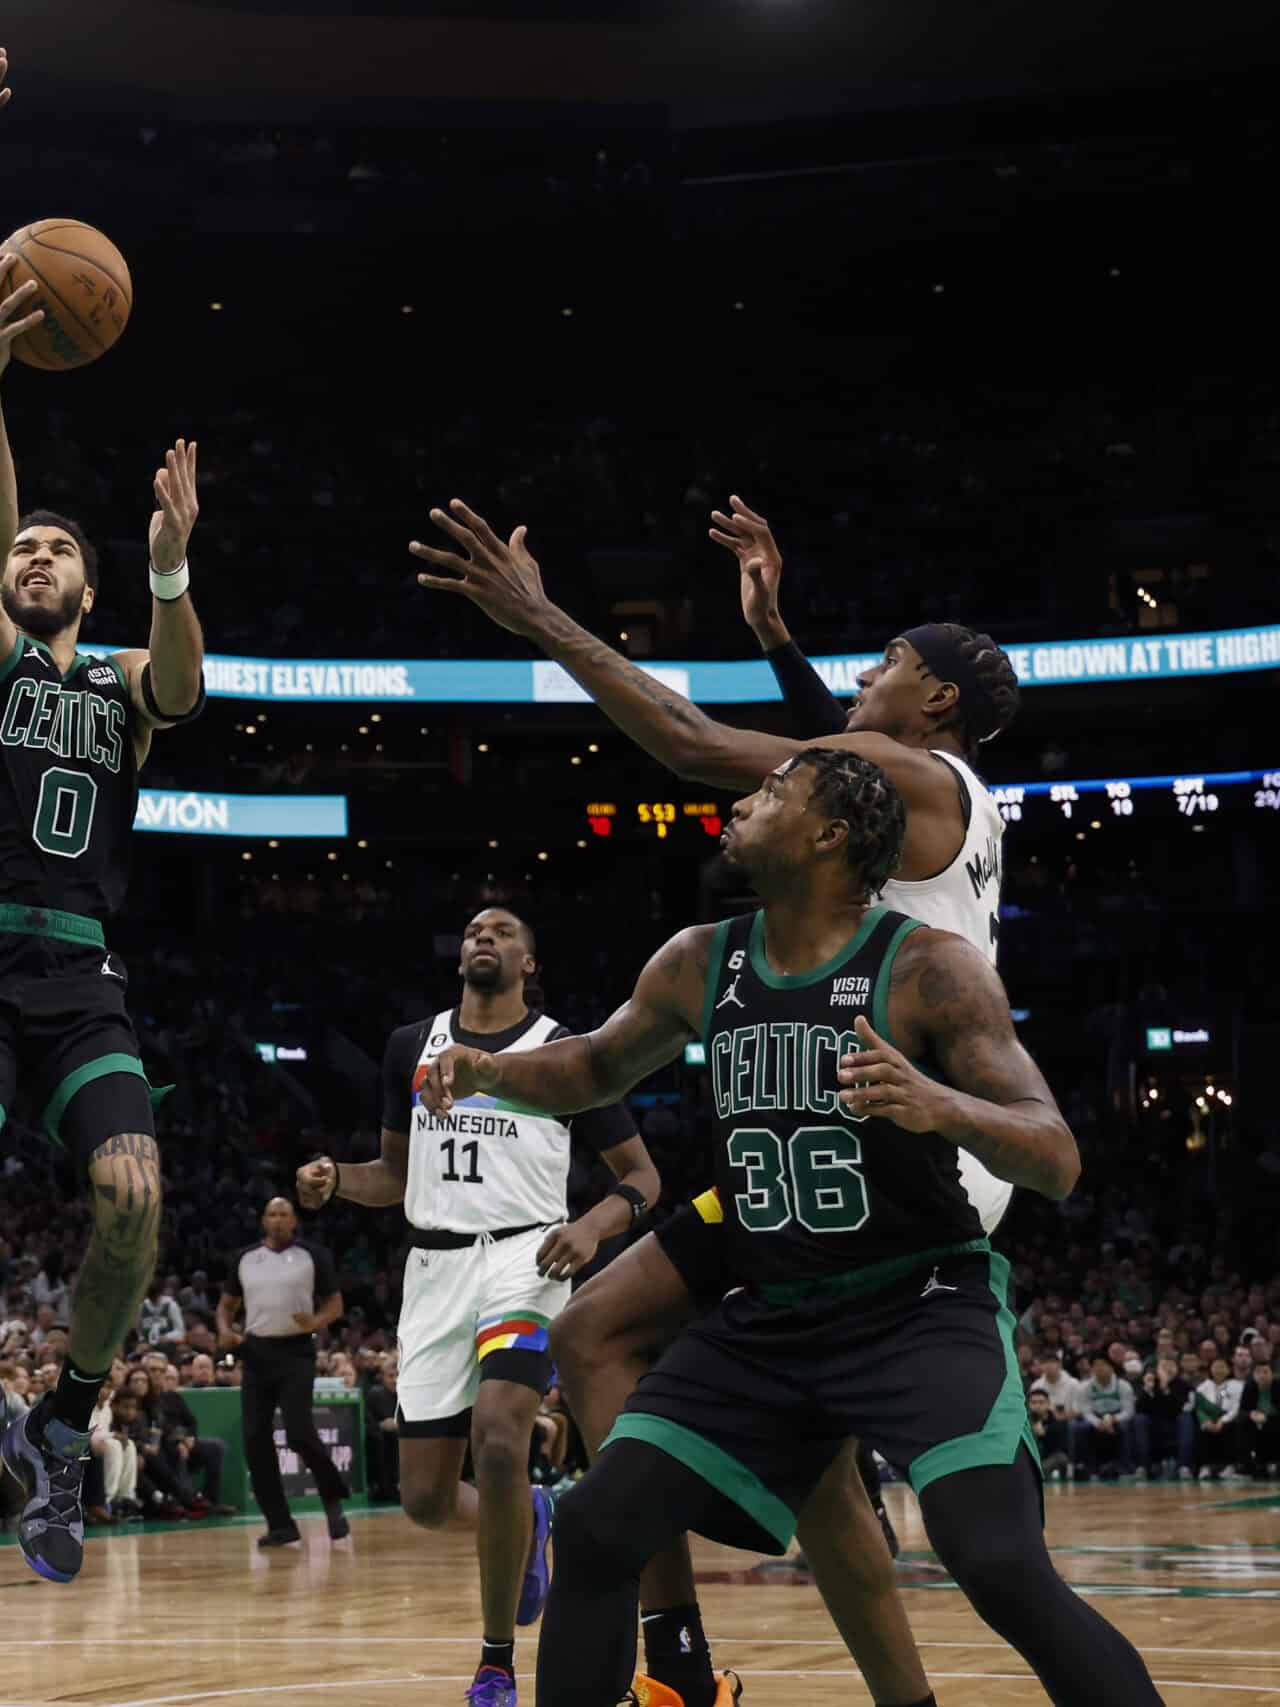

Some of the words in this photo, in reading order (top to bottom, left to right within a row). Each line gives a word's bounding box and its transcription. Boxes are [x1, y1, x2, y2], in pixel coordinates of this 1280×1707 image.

[202, 659, 269, 695] GHEST
[271, 664, 416, 697] ELEVATIONS.
[1033, 643, 1128, 679] GROWN
[1129, 641, 1163, 673] AT
[1163, 637, 1216, 671] THE
[0, 676, 126, 774] CELTICS
[31, 766, 98, 859] 0
[728, 951, 745, 970] 6
[829, 992, 869, 1007] PRINT
[832, 976, 870, 993] VISTA
[417, 1113, 519, 1139] MINNESOTA
[440, 1138, 484, 1184] 11
[726, 1126, 870, 1233] 36
